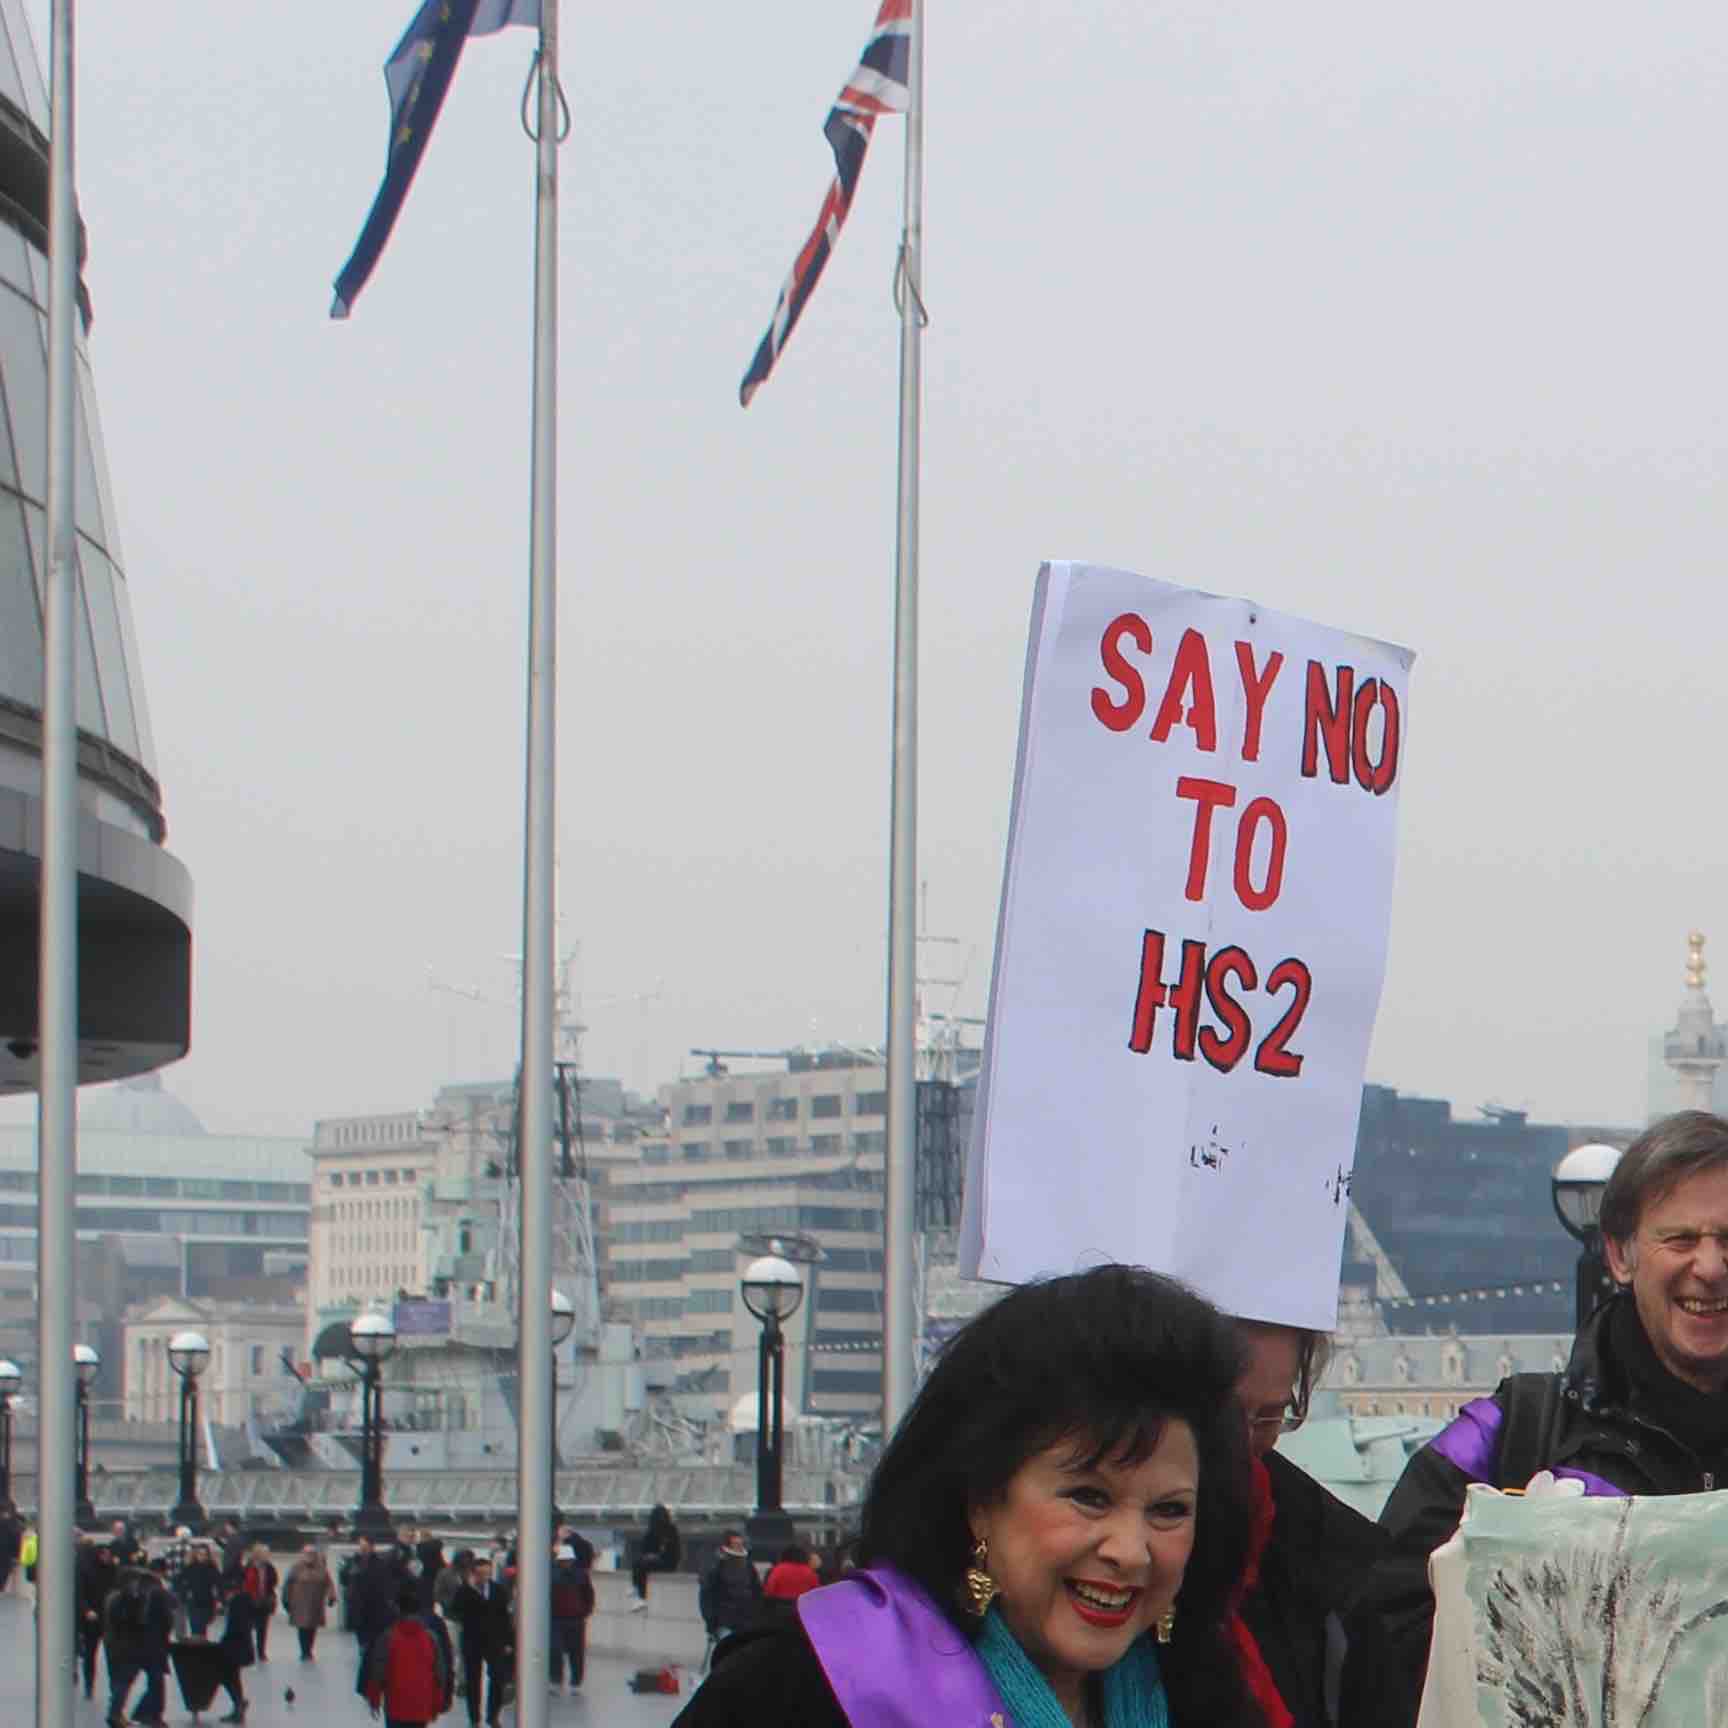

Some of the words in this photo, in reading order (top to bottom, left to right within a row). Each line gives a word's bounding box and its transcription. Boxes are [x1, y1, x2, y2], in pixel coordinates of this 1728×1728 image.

[1091, 611, 1283, 761] SAY
[1301, 658, 1400, 796] NO
[1176, 776, 1288, 912] TO
[1129, 928, 1312, 1077] HS2
